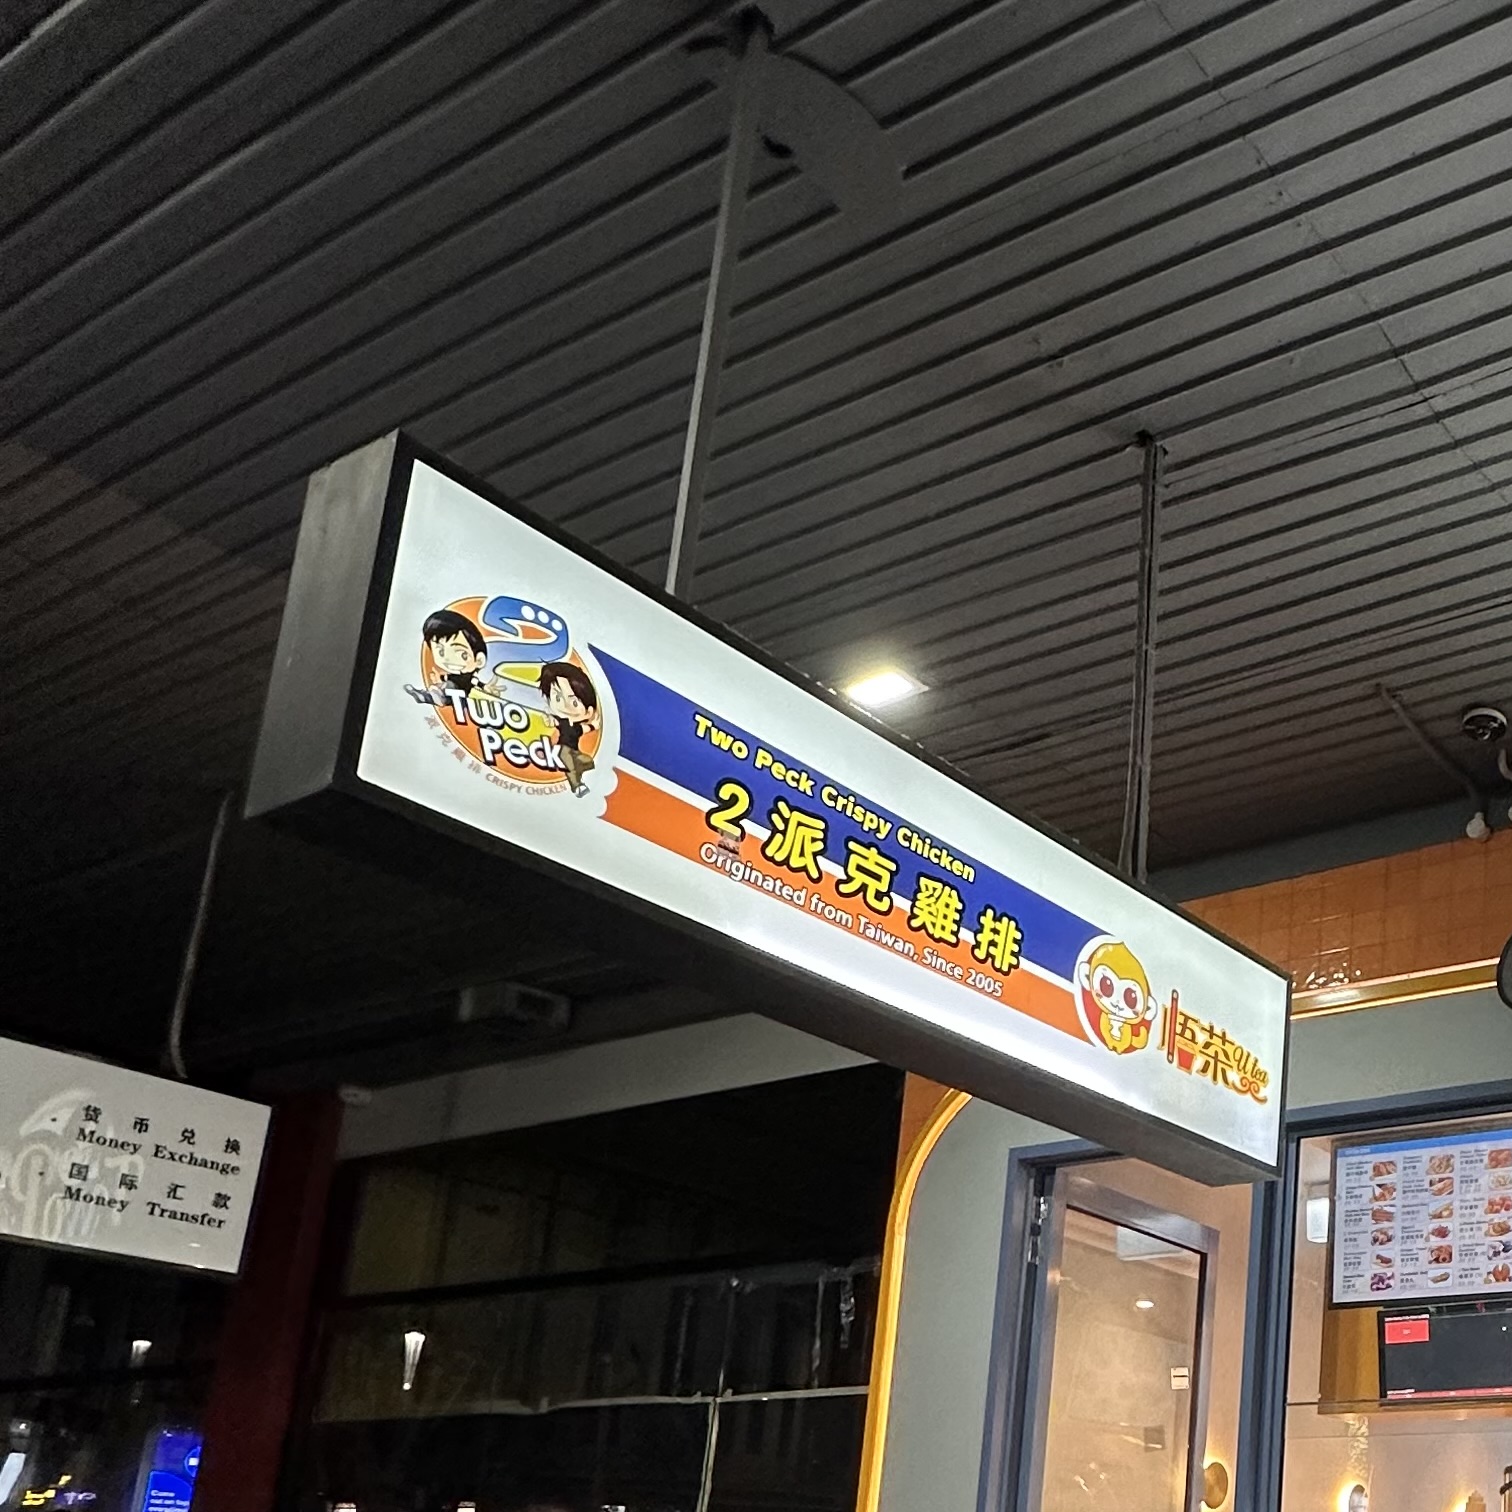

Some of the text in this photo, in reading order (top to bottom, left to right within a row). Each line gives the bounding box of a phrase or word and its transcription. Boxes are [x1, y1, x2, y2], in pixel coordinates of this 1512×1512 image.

[444, 688, 530, 732] Two
[478, 727, 570, 771] Peck
[485, 772, 567, 796] CRISPY CHICKEN
[694, 713, 976, 883] Two Peck Crispy Chicken
[700, 843, 1003, 998] Originated from Taiwan, Since 2005
[76, 1127, 241, 1176] Money Exchange
[83, 1104, 241, 1155] 货币兑换
[63, 1185, 226, 1230] Money Transfer
[68, 1162, 231, 1210] 国际汇款
